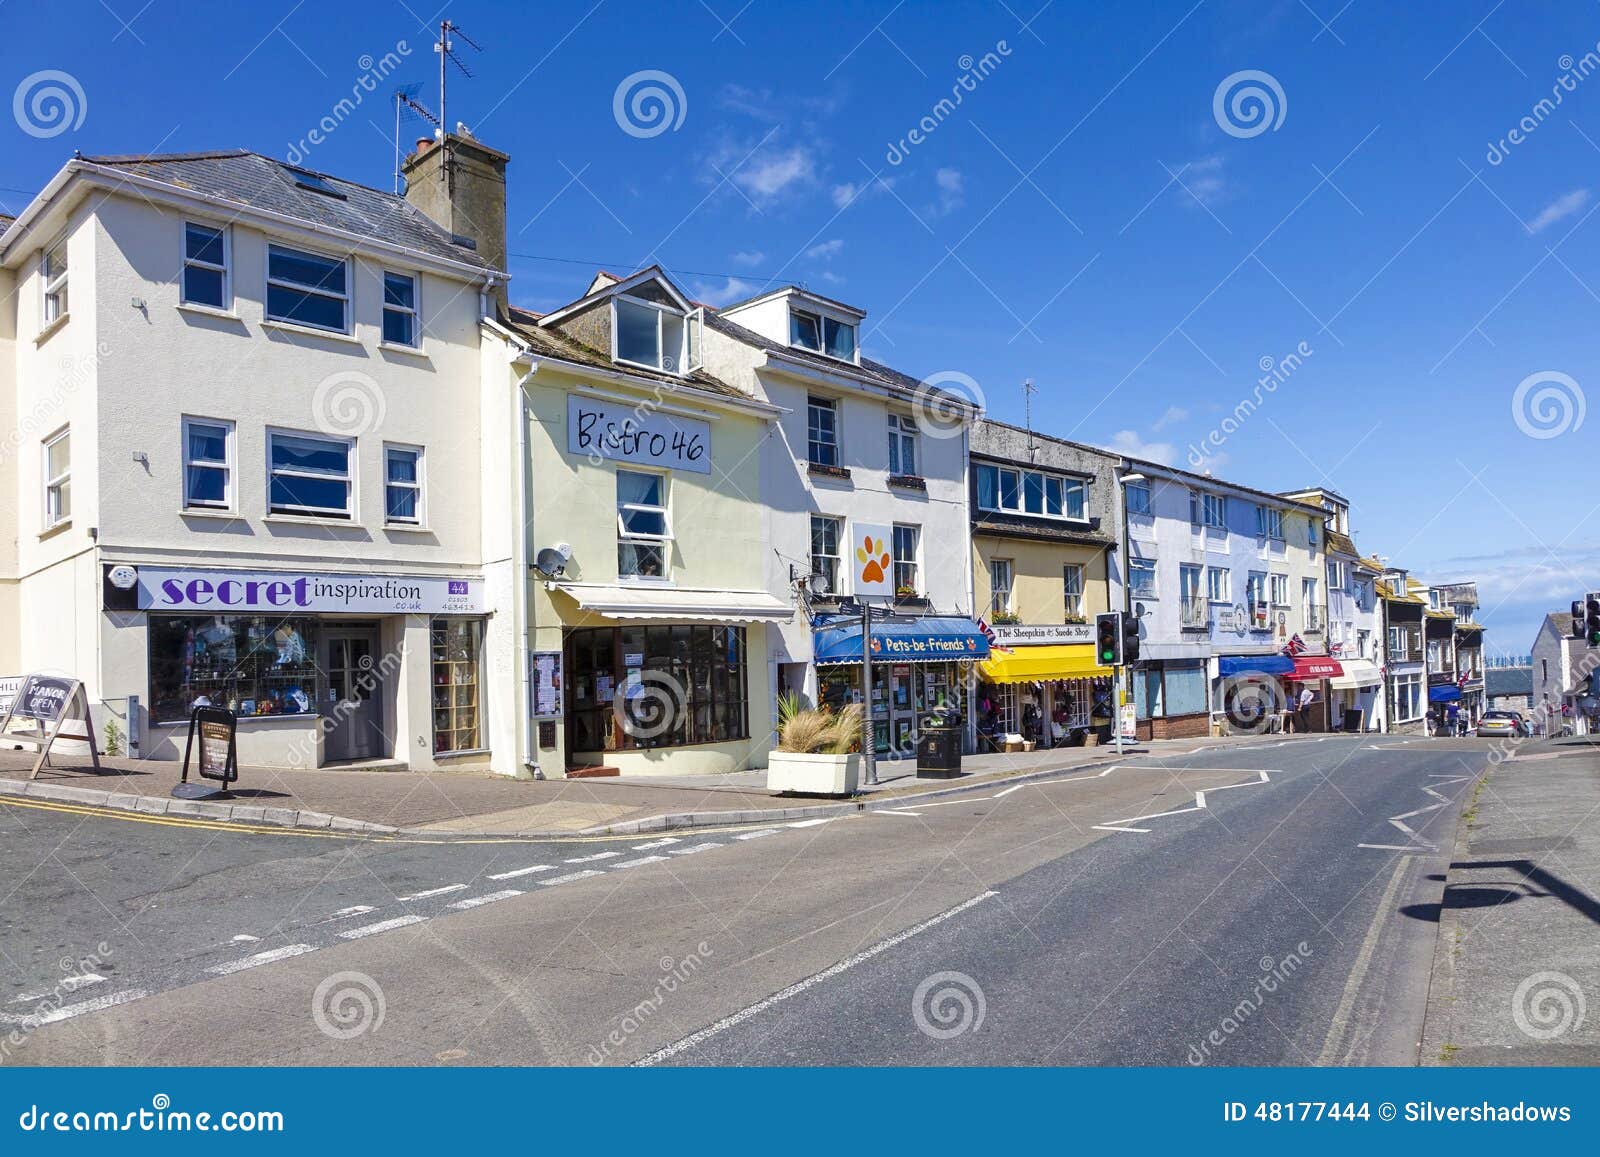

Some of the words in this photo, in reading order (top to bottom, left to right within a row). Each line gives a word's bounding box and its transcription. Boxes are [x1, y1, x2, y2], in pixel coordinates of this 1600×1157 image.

[578, 409, 666, 457] Bistro
[671, 431, 704, 461] 46
[161, 577, 313, 607] secret
[314, 578, 421, 605] inspiration
[451, 583, 465, 594] 44
[997, 628, 1012, 638] The
[1055, 627, 1073, 637] Suede
[1074, 627, 1090, 639] Shop
[886, 637, 965, 652] Pets-be-Friends
[30, 697, 57, 708] OPEN
